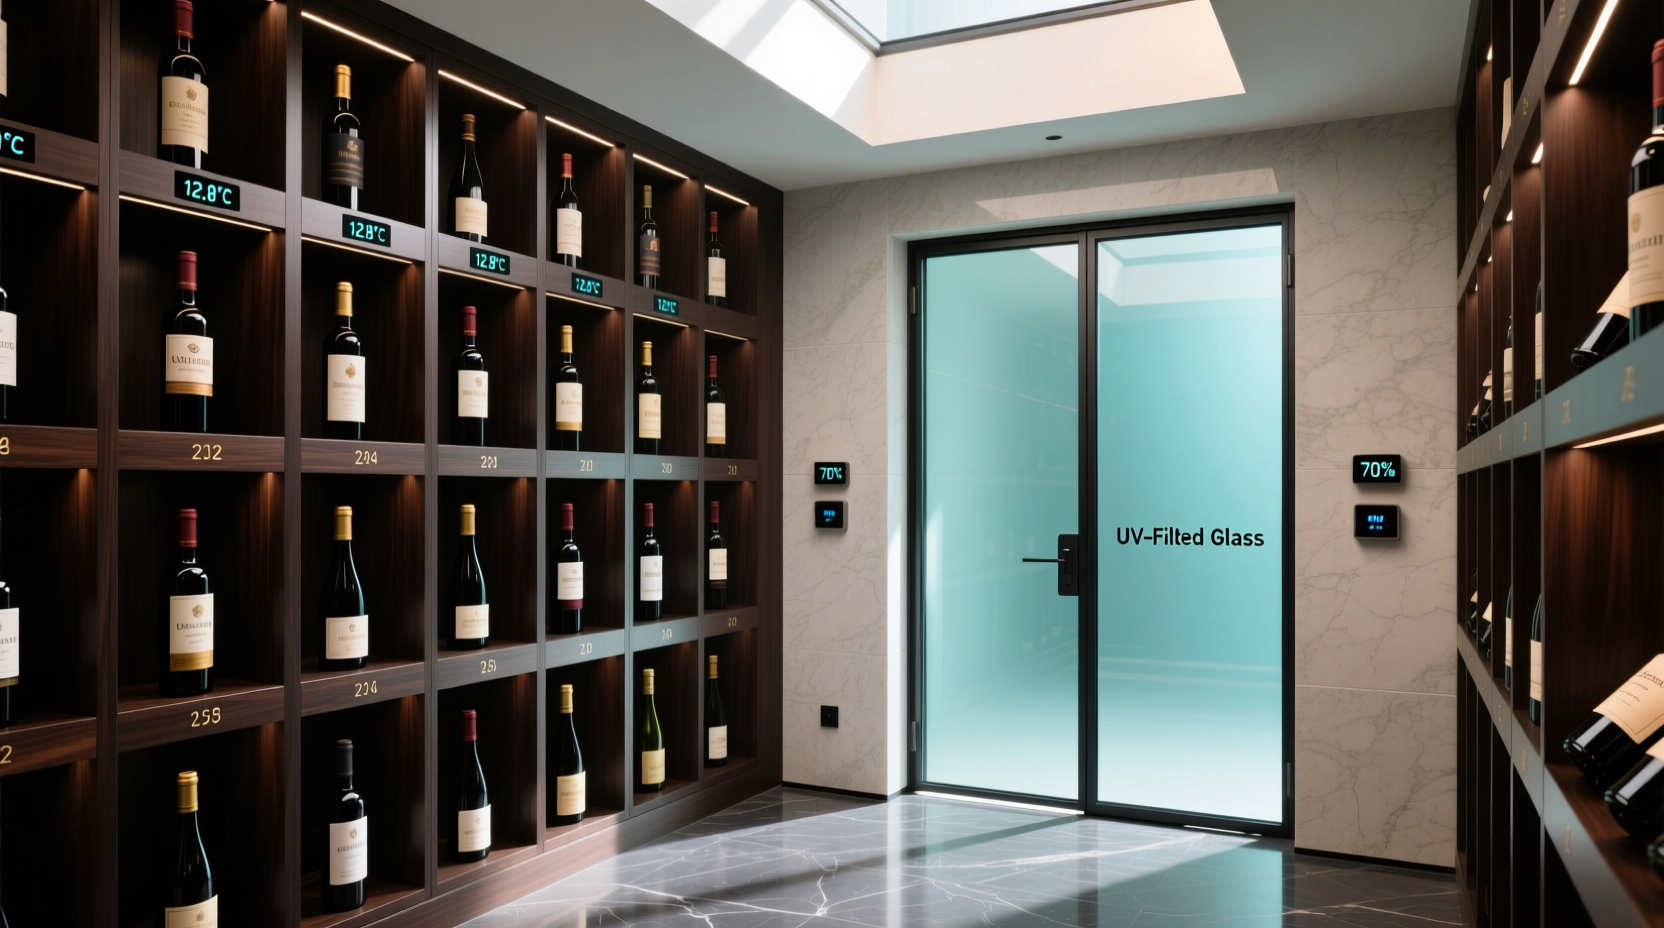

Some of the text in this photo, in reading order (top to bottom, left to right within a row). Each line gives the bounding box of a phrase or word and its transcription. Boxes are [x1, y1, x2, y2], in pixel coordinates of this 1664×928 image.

[184, 179, 232, 205] 12.8°C
[819, 467, 842, 480] 70%
[1360, 461, 1396, 478] 70%
[1116, 526, 1265, 547] UV-Filted Glass
